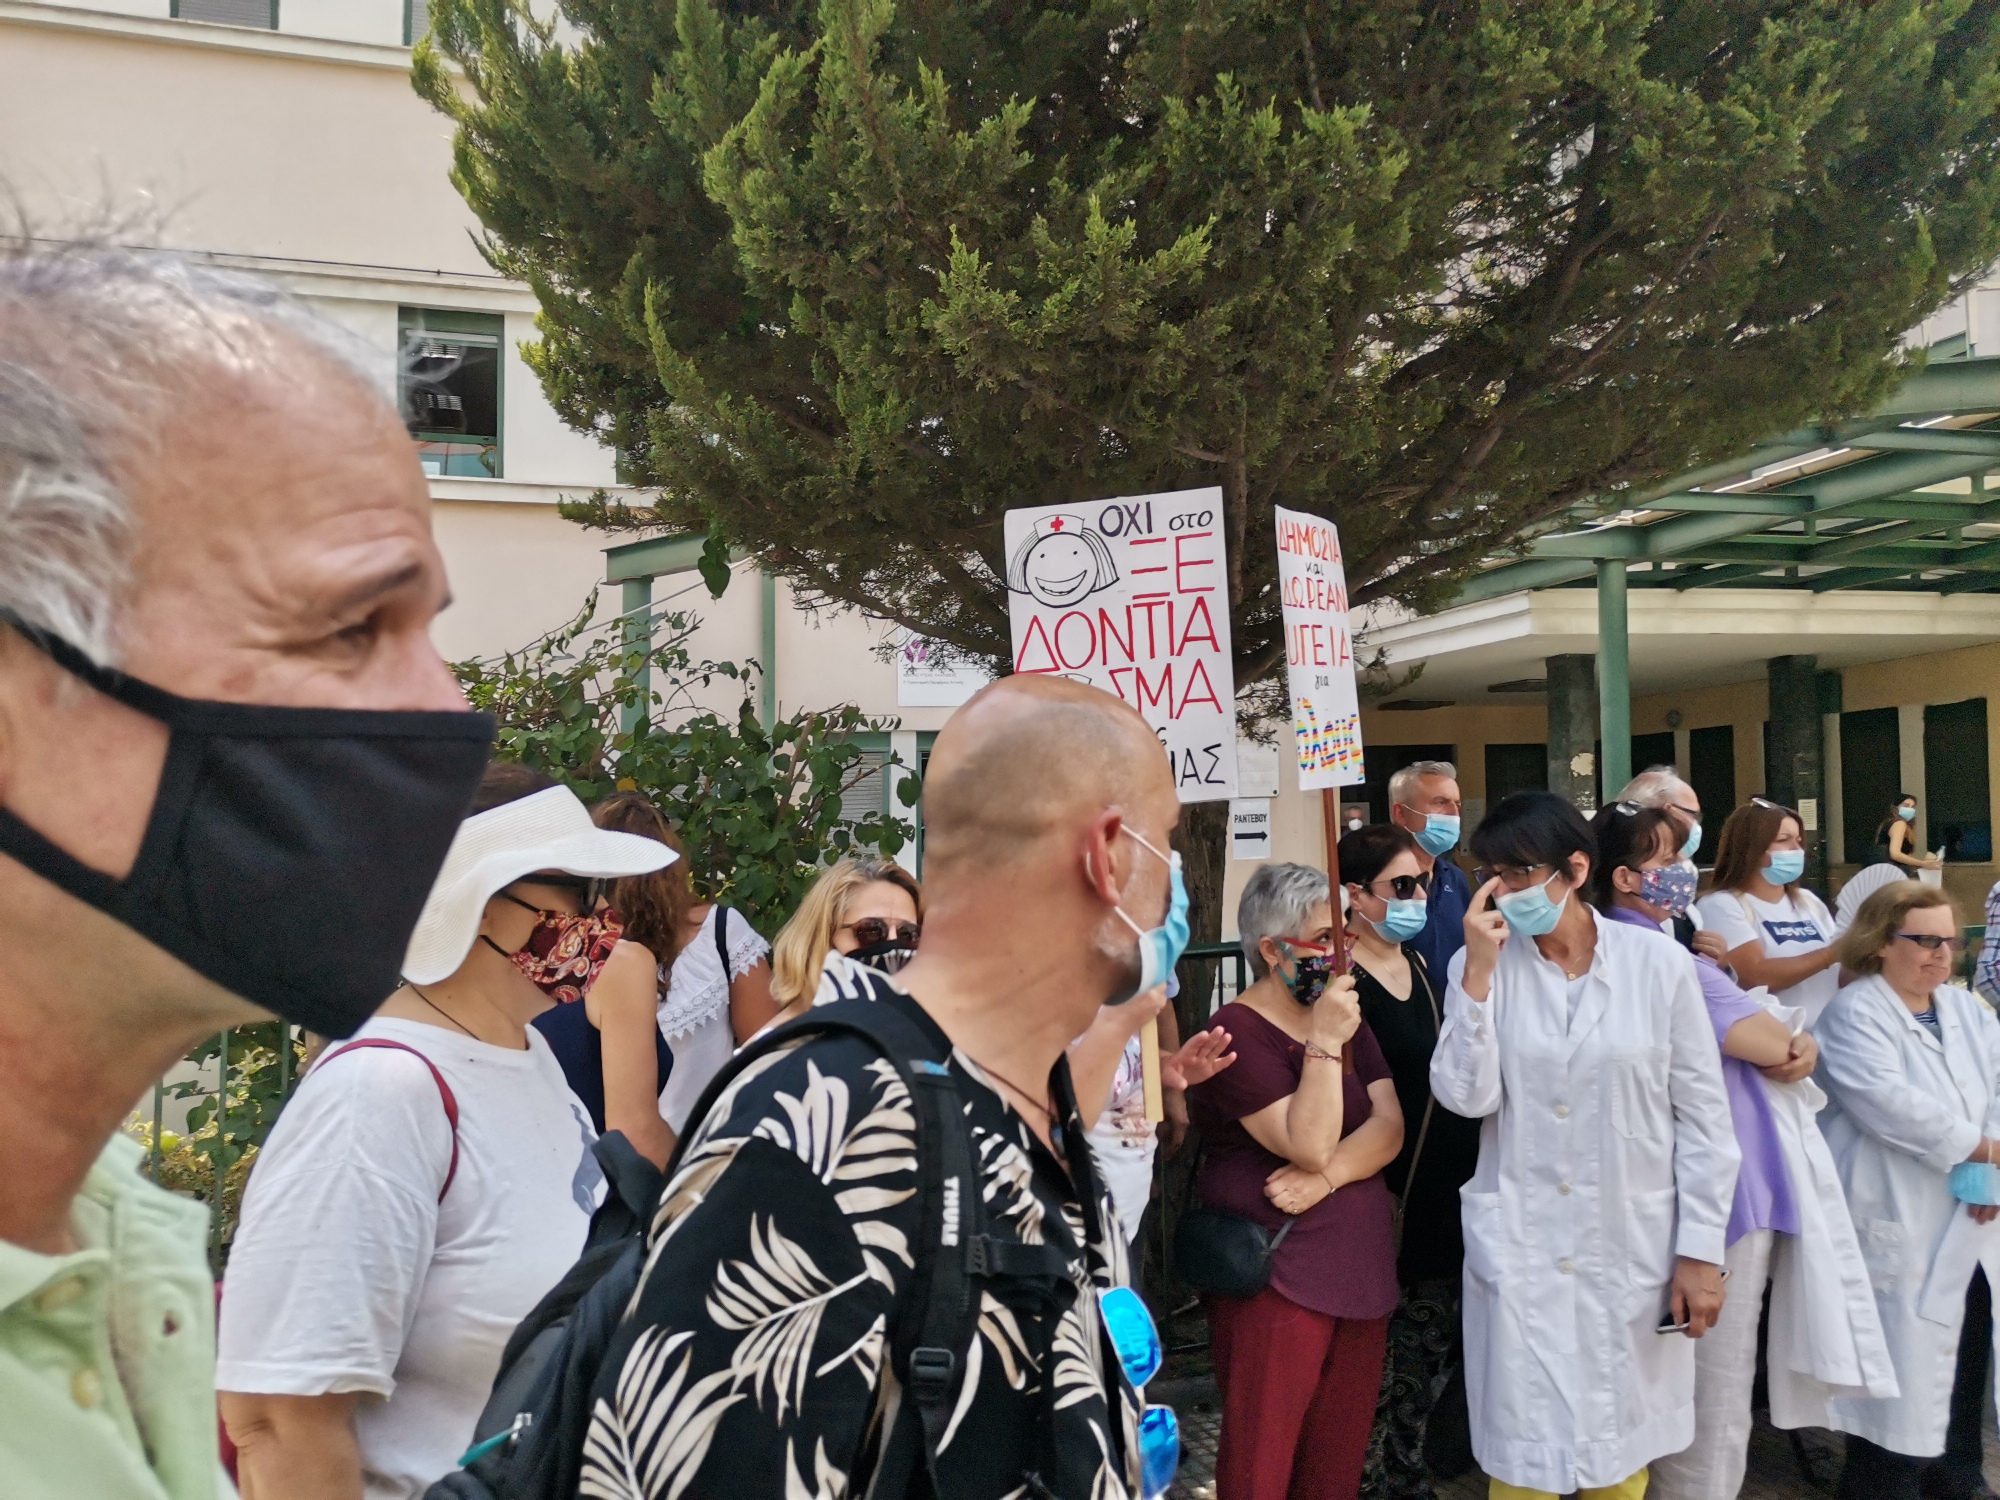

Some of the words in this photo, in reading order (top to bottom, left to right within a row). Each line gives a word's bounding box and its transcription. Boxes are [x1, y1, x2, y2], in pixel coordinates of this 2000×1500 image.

[1098, 501, 1153, 537] ΟΧΙ
[1169, 510, 1213, 531] στο
[1279, 516, 1343, 566] ΔΗΜΟΣΙΑ
[1129, 531, 1215, 600] ΞΕ
[1305, 562, 1324, 576] και
[1283, 576, 1349, 614] ΔΩΡΕΑΝ
[1014, 596, 1220, 674] ΔΟΝΤΙΑ
[1109, 658, 1223, 719] ΣΜΑ
[1314, 674, 1330, 690] για
[1170, 743, 1225, 789] ΙΑΣ
[1234, 813, 1267, 823] ΡΑΝΤΕΒΟΥ
[941, 1176, 959, 1247] THULE
